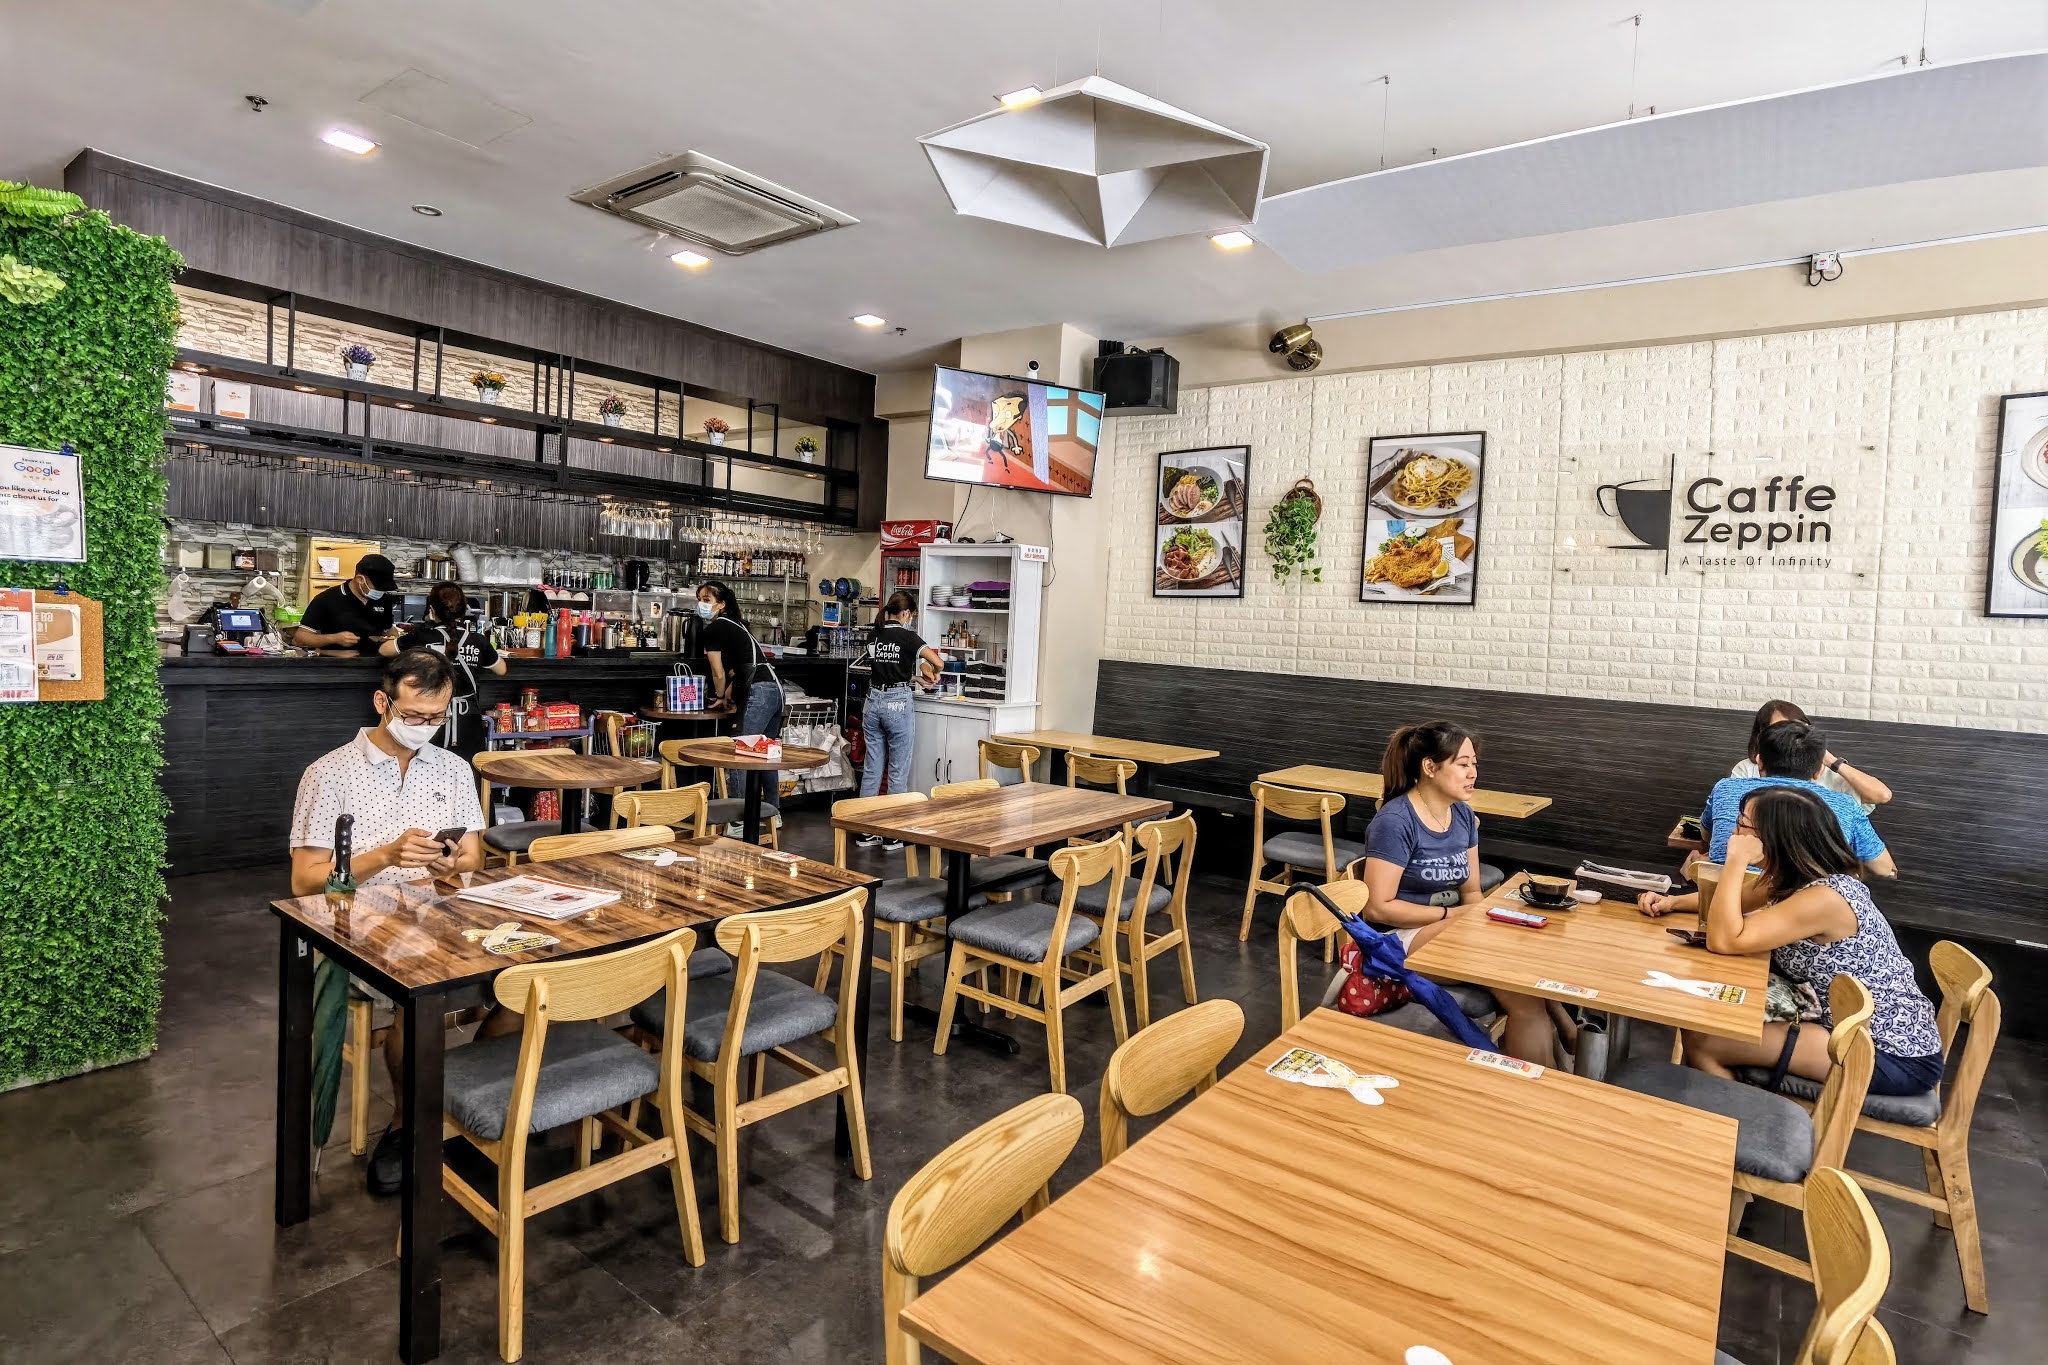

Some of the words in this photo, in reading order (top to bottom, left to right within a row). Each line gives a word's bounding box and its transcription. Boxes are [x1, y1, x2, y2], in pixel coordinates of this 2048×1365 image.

[14, 461, 60, 476] Google
[11, 484, 26, 492] like
[1687, 475, 1836, 513] Caffe
[1684, 513, 1832, 550] Zeppin
[1682, 556, 1689, 566] A
[1698, 556, 1737, 566] Taste
[1746, 556, 1763, 566] Of
[1772, 556, 1832, 568] Infinity
[459, 645, 480, 655] affe
[876, 642, 900, 652] Caffe
[875, 651, 900, 660] Zeppin
[1421, 866, 1470, 881] CURIOU
